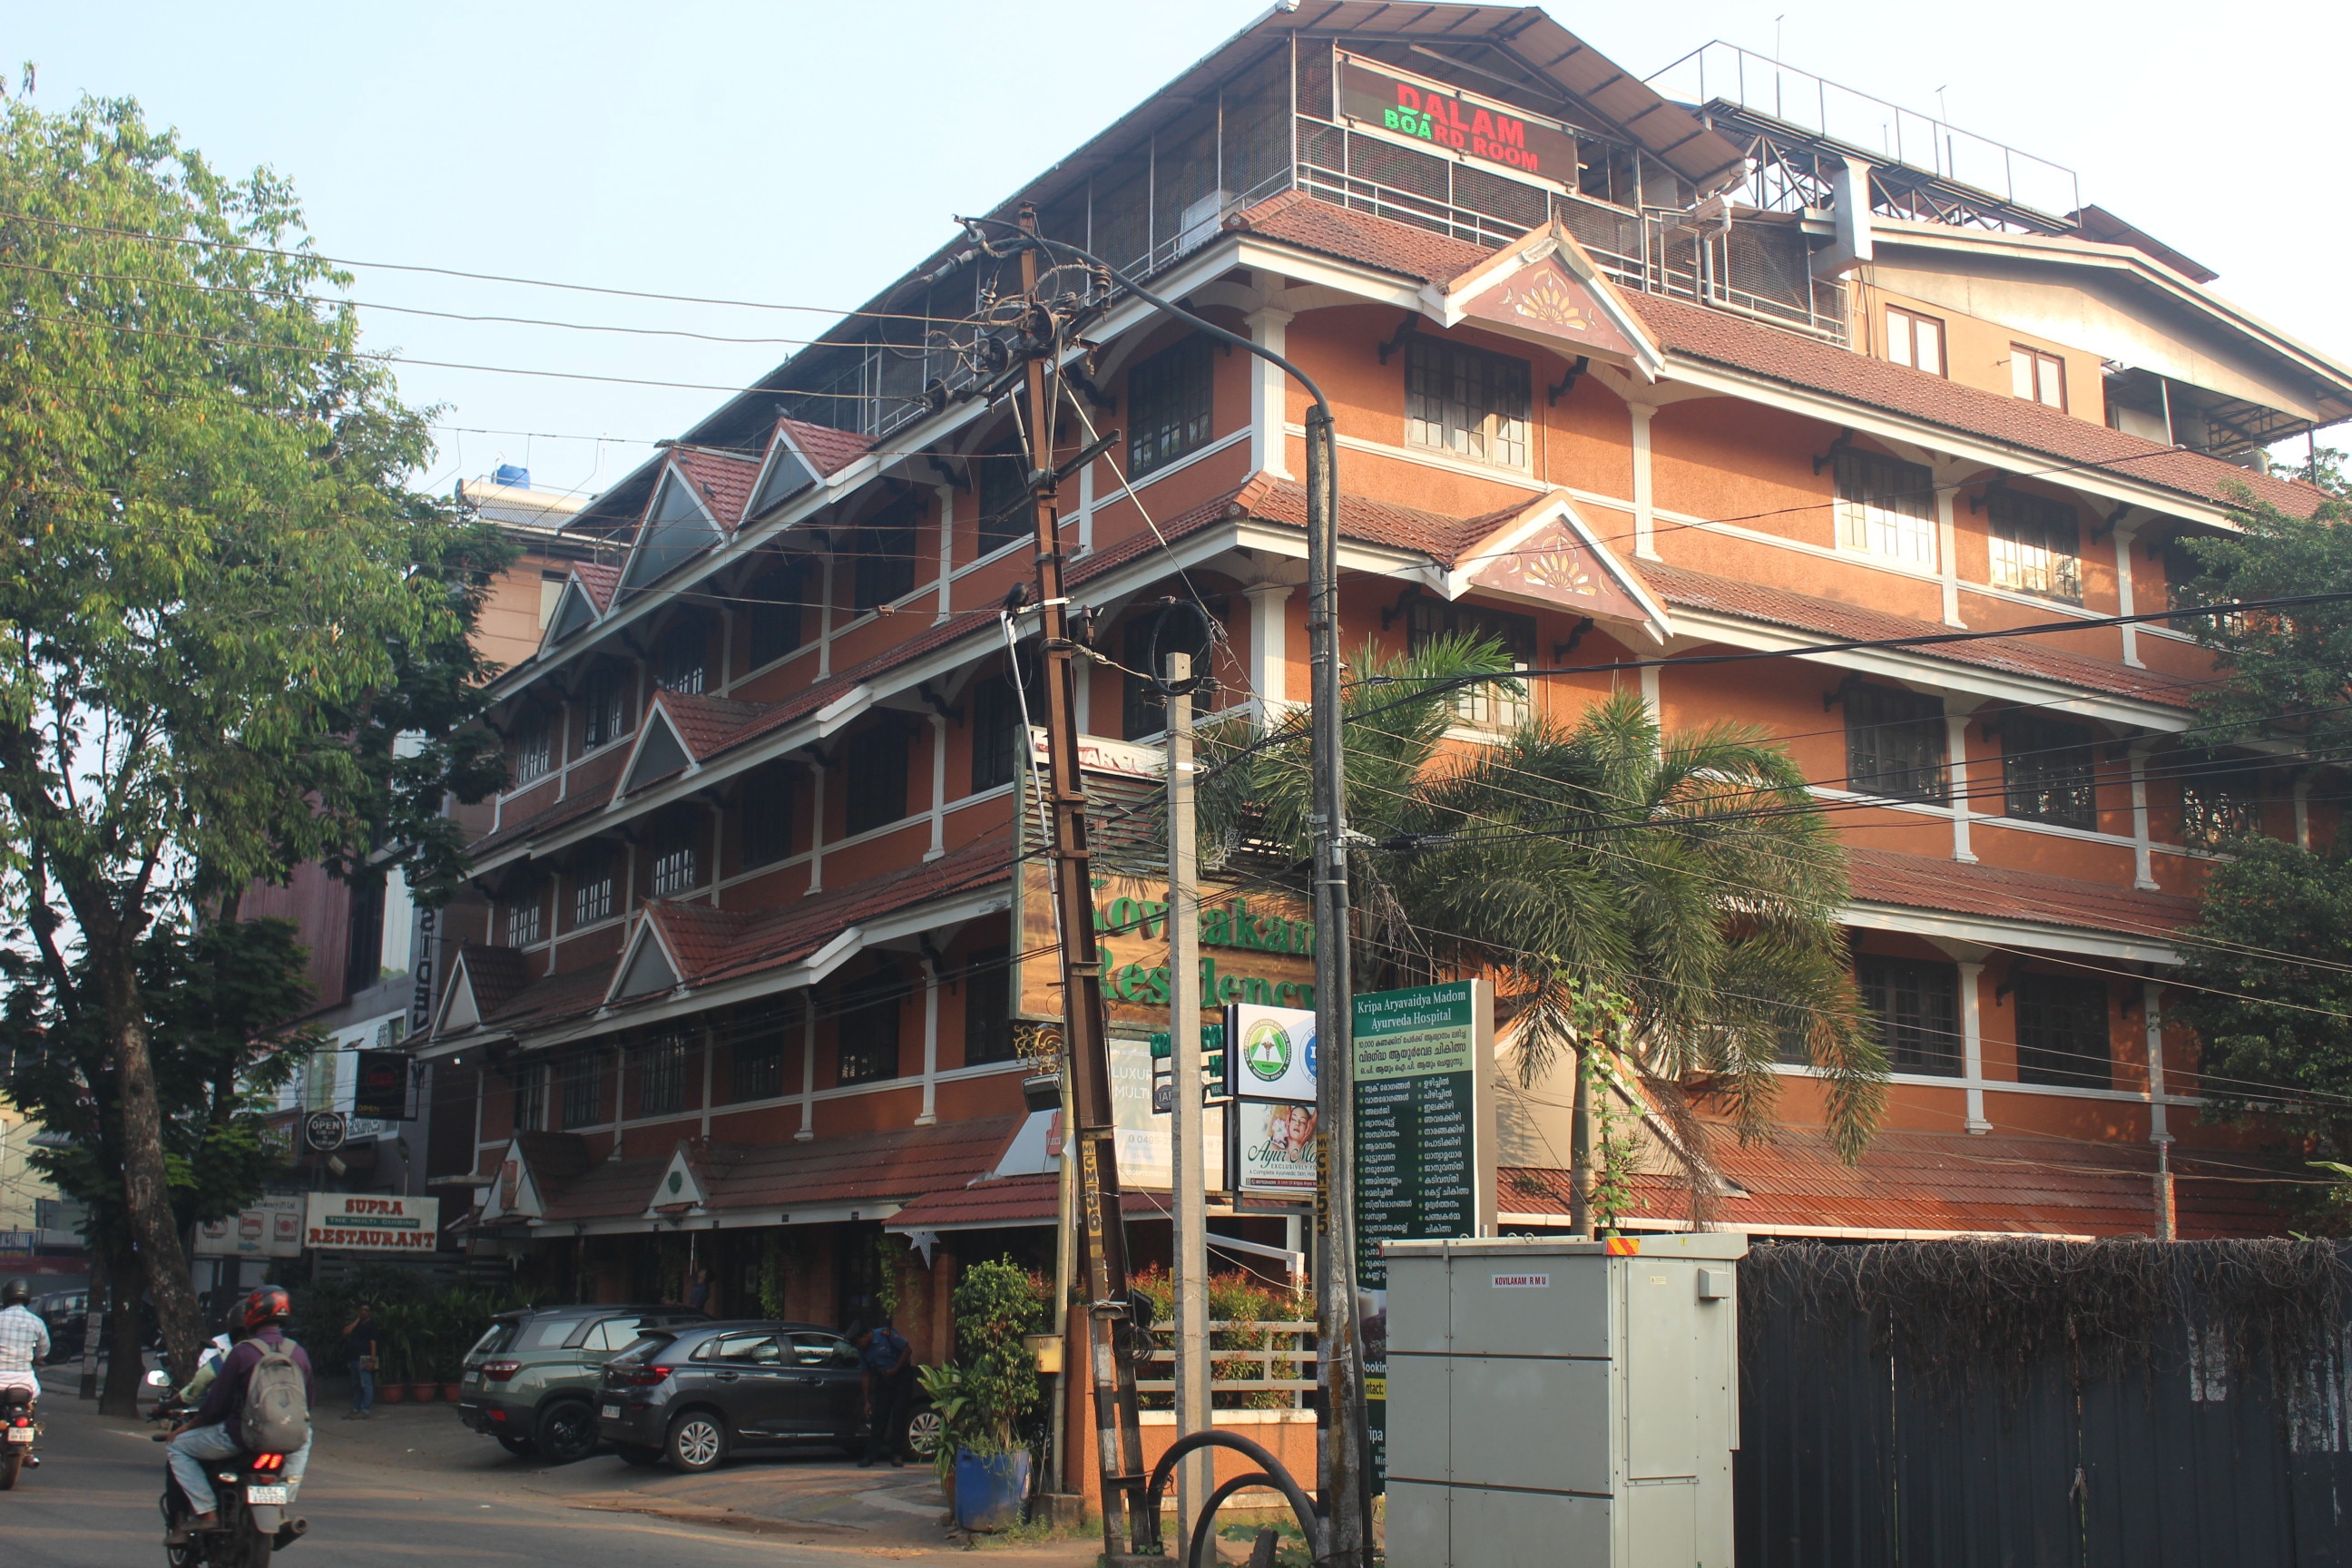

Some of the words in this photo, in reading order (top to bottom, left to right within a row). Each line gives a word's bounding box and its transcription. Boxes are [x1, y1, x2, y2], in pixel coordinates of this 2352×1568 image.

[1397, 83, 1524, 149] DALAM
[1384, 108, 1465, 149] BOARD
[1472, 137, 1538, 172] ROOM
[1357, 1000, 1382, 1014] Kripa
[1384, 994, 1431, 1013] Aryavaidya
[1433, 989, 1466, 1004] Madom
[1371, 1014, 1412, 1032] Ayurveda
[1414, 1008, 1452, 1026] Hospital
[1112, 1066, 1152, 1081] LUXUR
[311, 1120, 339, 1131] OPEN
[1248, 1136, 1288, 1168] Ayur
[345, 1199, 404, 1216] SUPRA
[309, 1229, 436, 1248] RESTAURANT
[1494, 1276, 1527, 1285] KOVILAKAM
